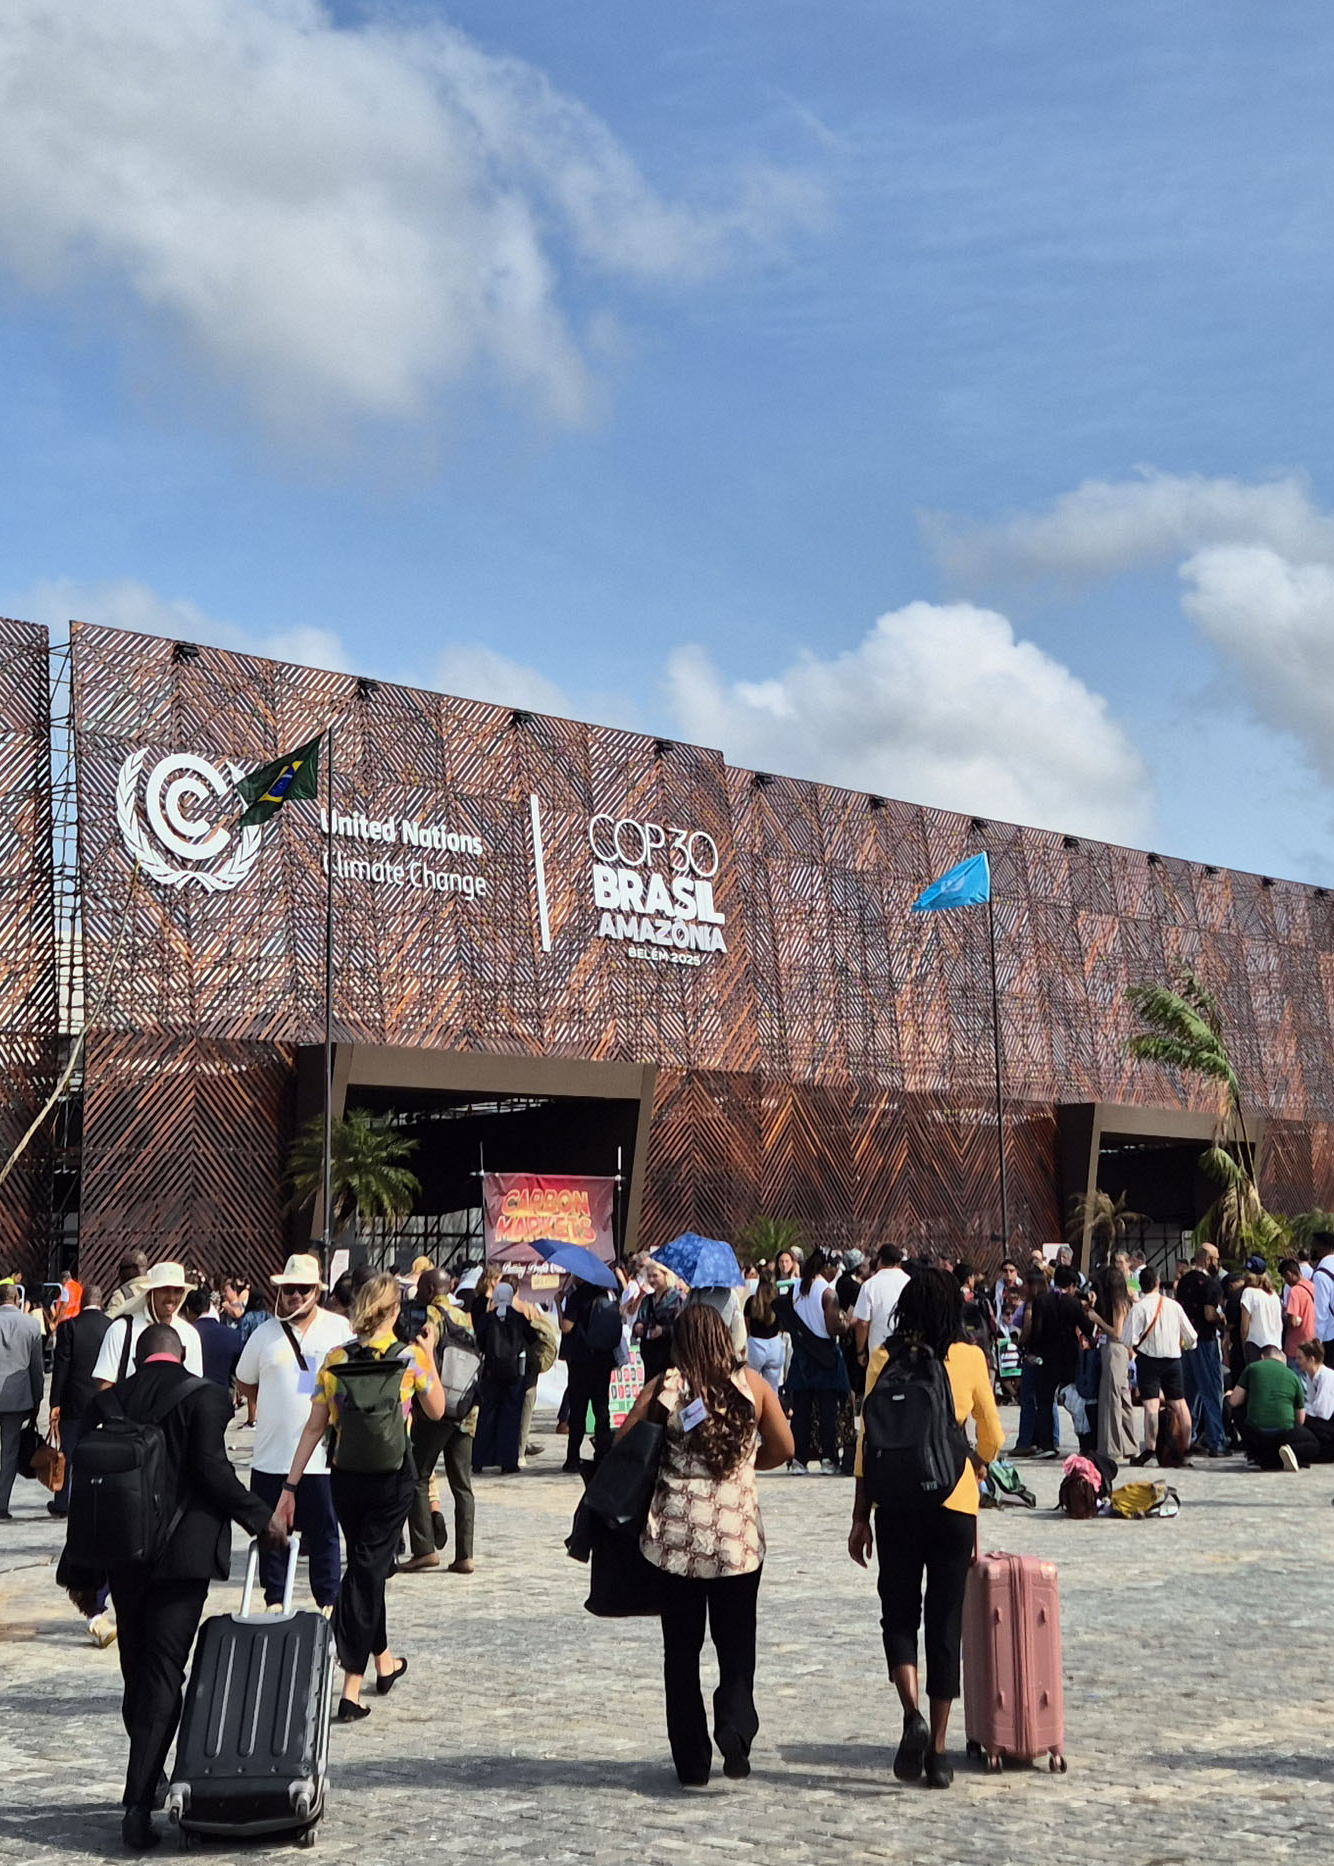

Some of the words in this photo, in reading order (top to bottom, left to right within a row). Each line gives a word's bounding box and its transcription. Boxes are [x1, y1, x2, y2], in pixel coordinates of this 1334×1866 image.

[320, 807, 396, 842] United
[402, 819, 483, 855] Nations
[323, 850, 405, 886] Climate
[410, 862, 486, 900] Change
[593, 864, 725, 925] BRASIL
[599, 912, 728, 953] AMAZÔNIA
[628, 947, 668, 962] BELÉM
[672, 952, 701, 967] 2025
[501, 1188, 591, 1218] CARBON
[495, 1215, 596, 1246] MARKETS
